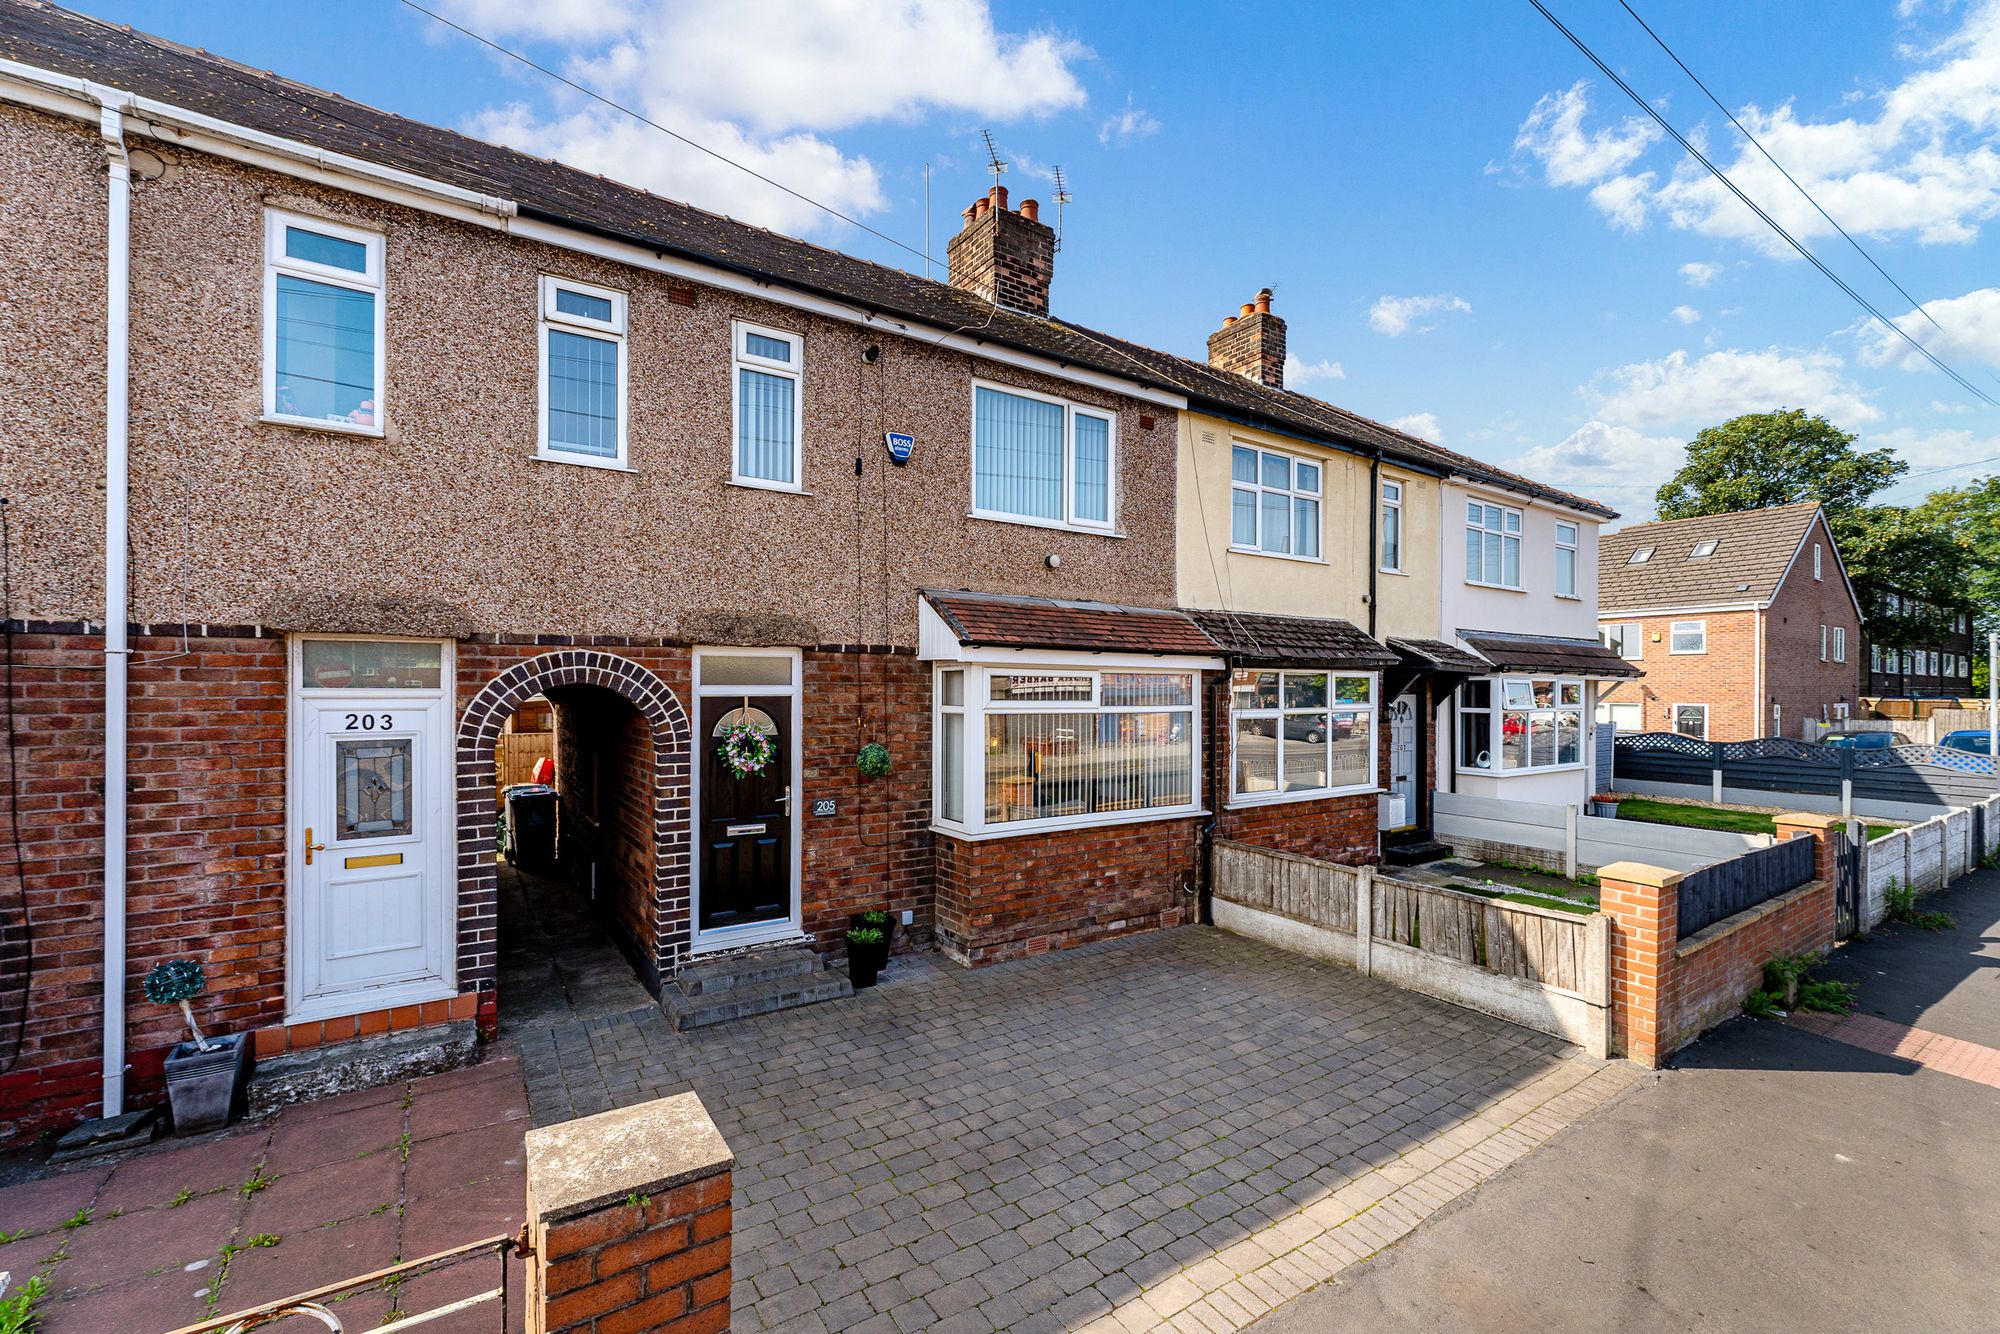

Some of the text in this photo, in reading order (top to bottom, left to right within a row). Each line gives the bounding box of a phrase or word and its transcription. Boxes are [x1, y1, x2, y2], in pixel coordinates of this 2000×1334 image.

[892, 437, 912, 448] BOSS
[345, 713, 393, 731] 203
[816, 800, 836, 811] 205
